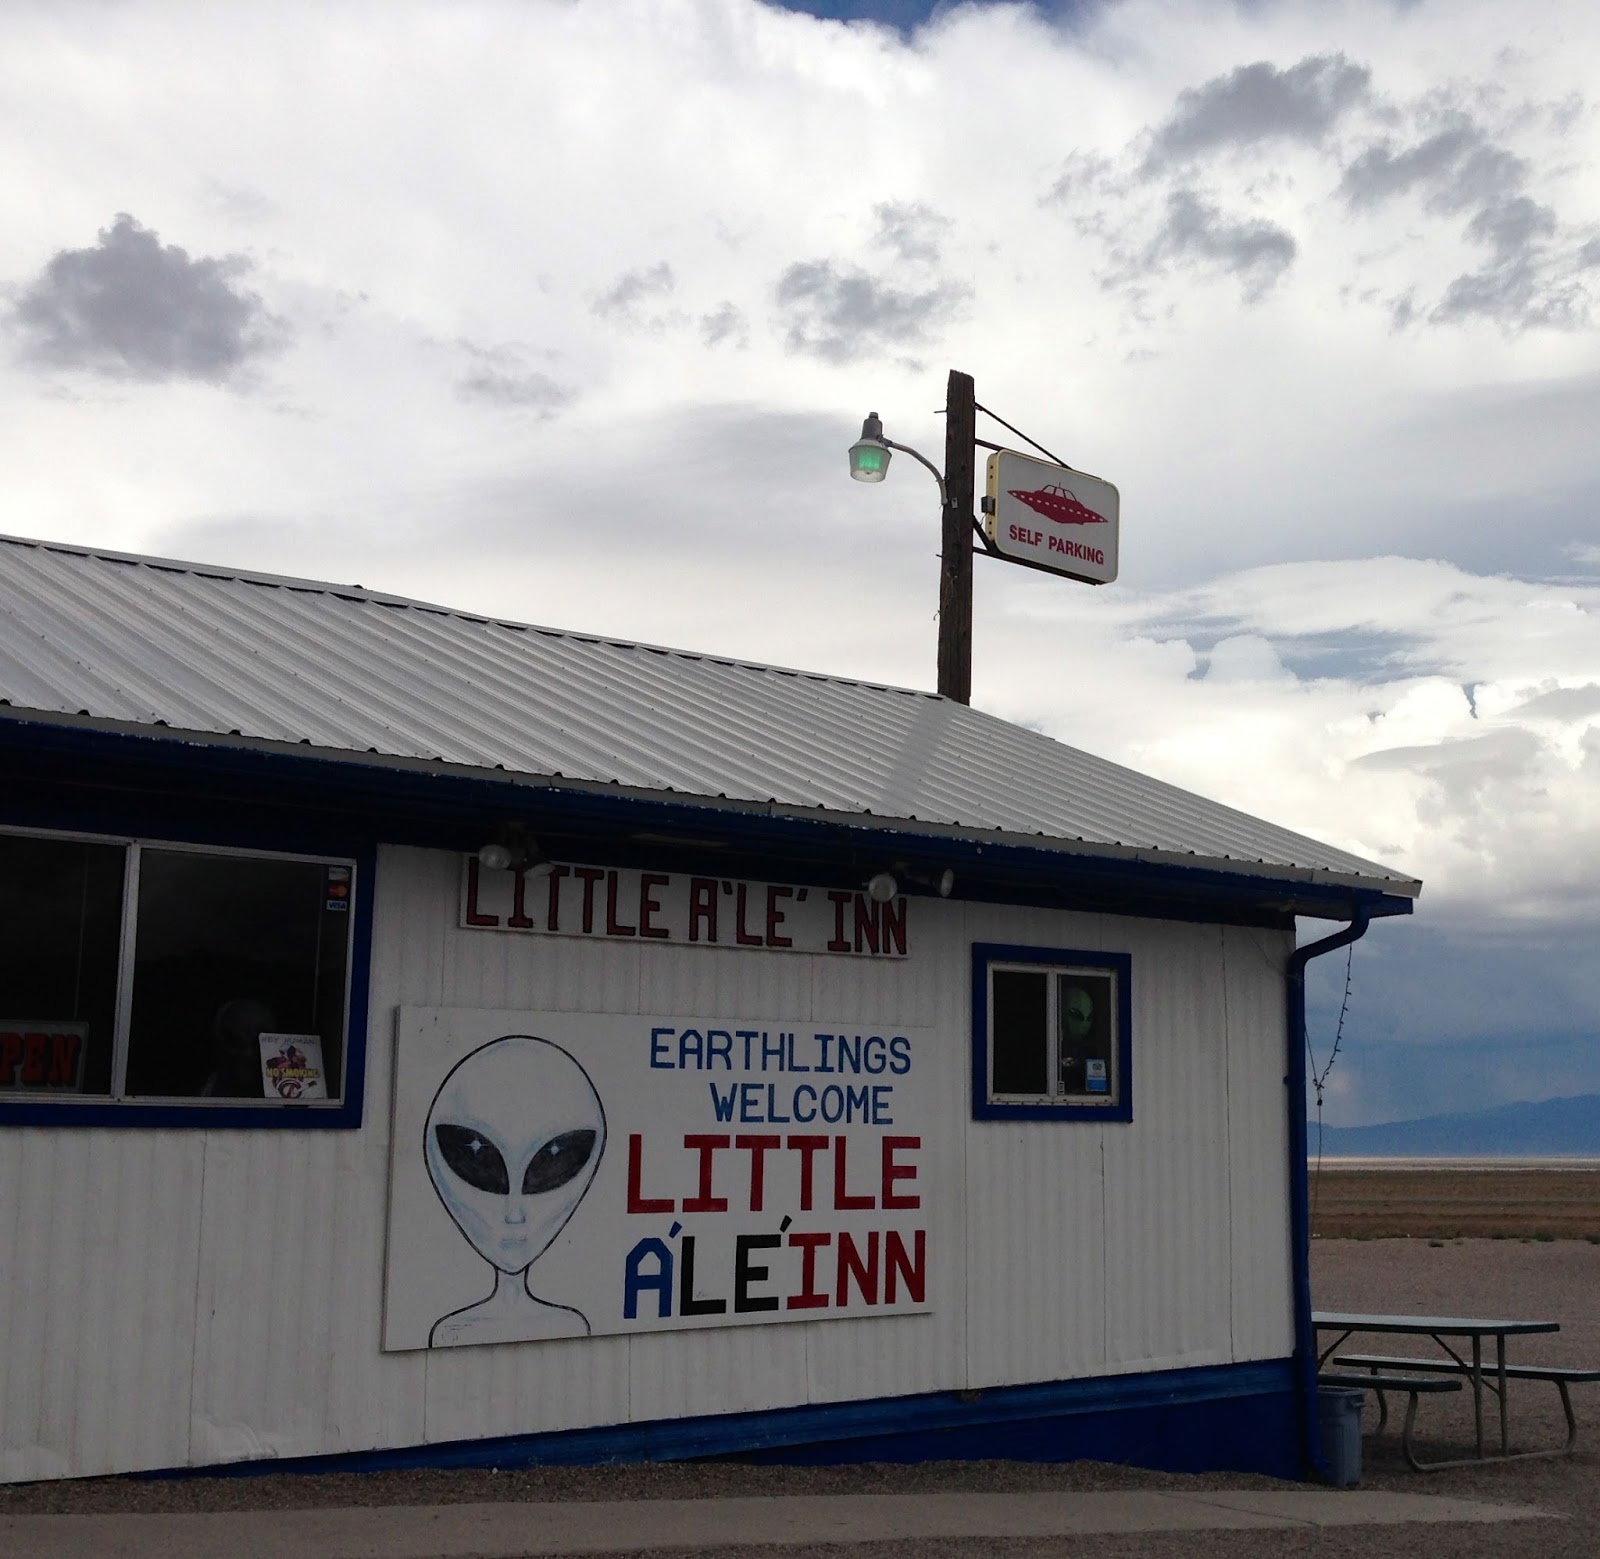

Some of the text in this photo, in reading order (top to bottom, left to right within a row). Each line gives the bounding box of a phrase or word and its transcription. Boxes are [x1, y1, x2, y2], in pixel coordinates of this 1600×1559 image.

[1009, 524, 1104, 565] SELF PARKING
[466, 856, 669, 938] LITTLE
[827, 890, 907, 955] INN
[266, 1067, 320, 1079] NO SMOKING
[650, 1028, 911, 1074] EARTHLINGS
[709, 1082, 893, 1125] WELCOME
[626, 1133, 921, 1214] LITTLE
